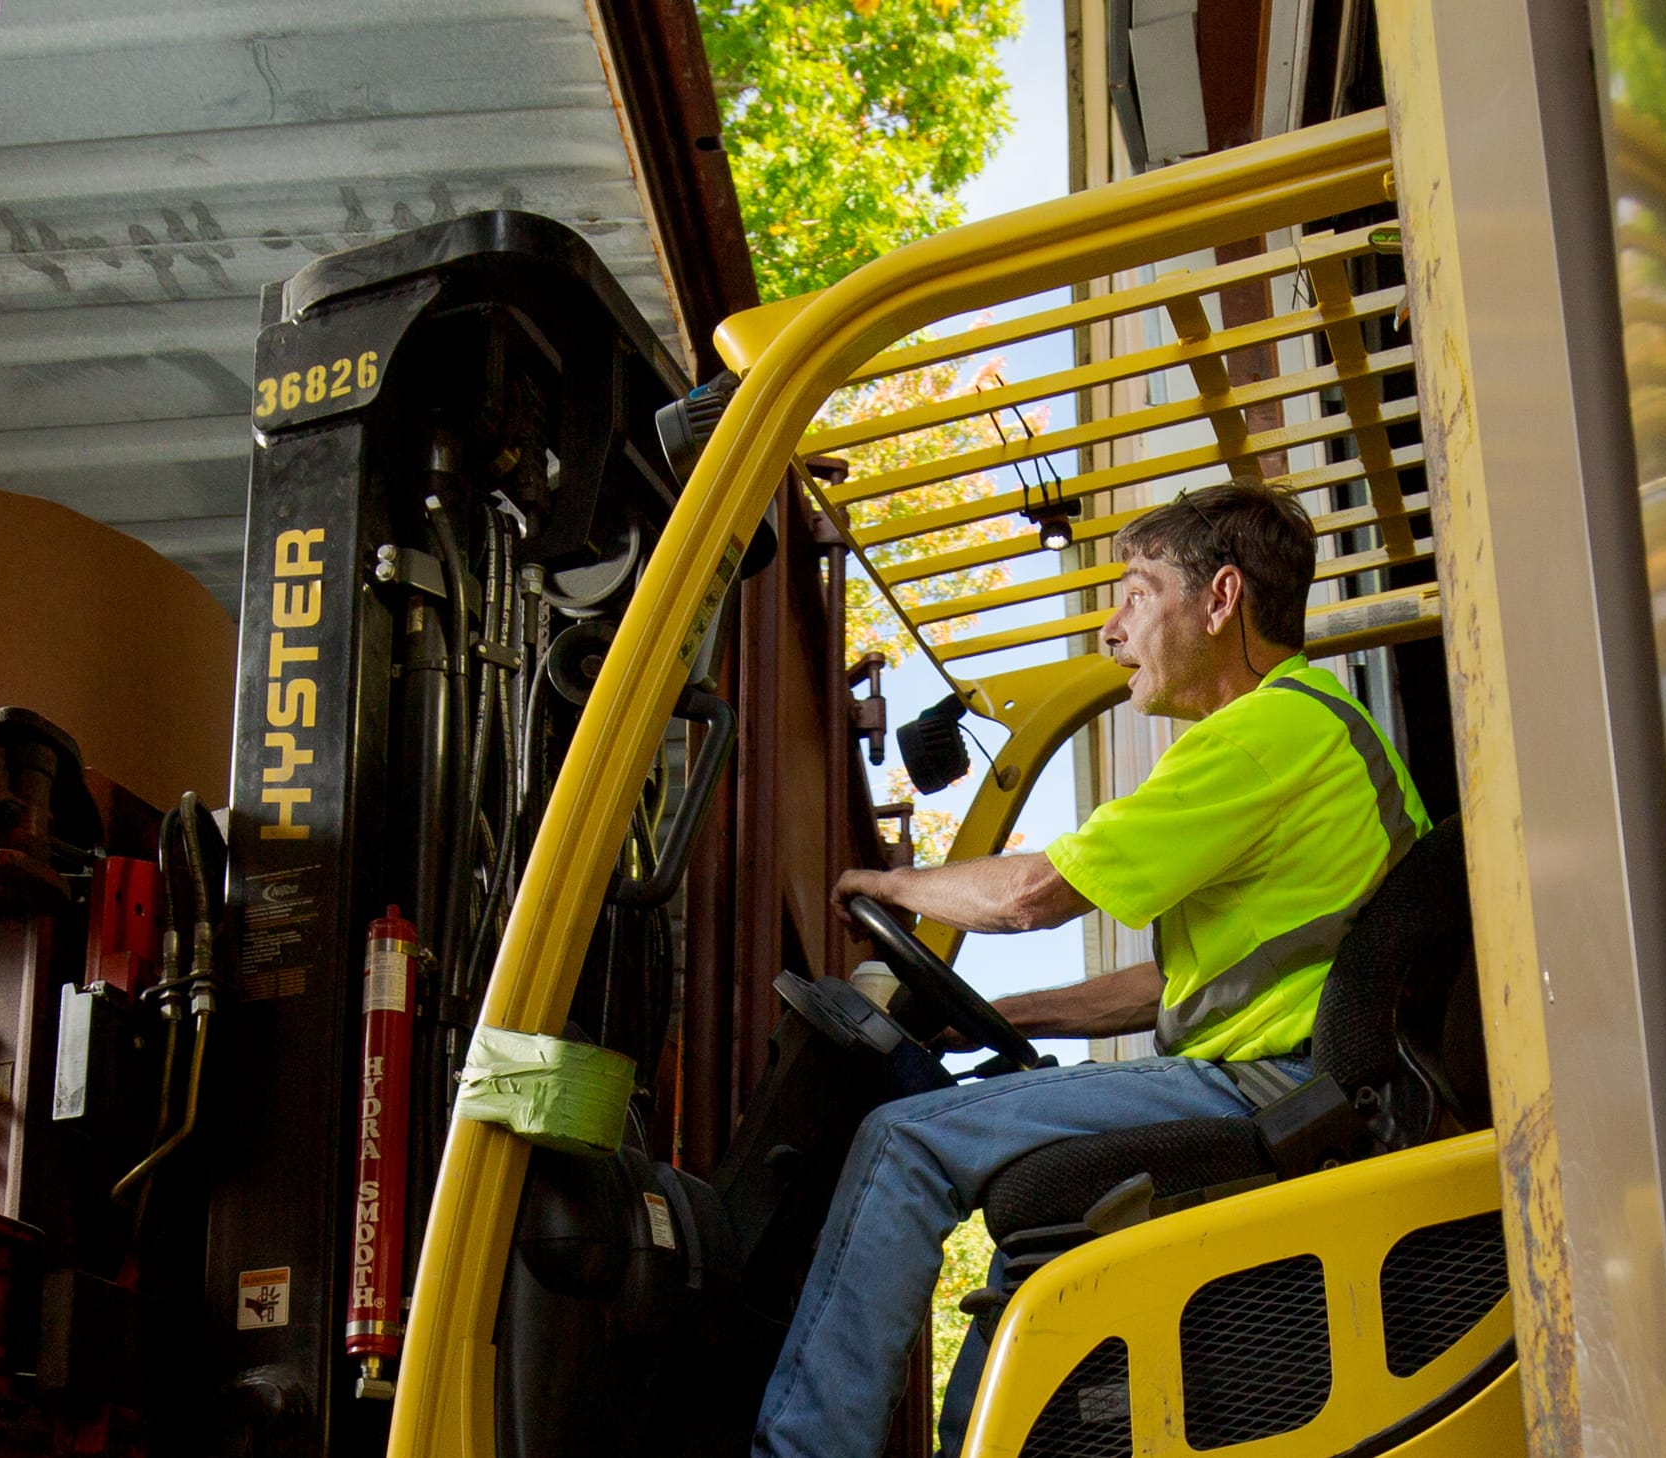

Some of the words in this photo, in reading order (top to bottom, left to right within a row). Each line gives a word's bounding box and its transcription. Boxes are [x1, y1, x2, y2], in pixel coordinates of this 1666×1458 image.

[255, 350, 378, 418] 36826
[259, 527, 325, 841] HYSTER
[359, 1056, 383, 1161] HYDRA
